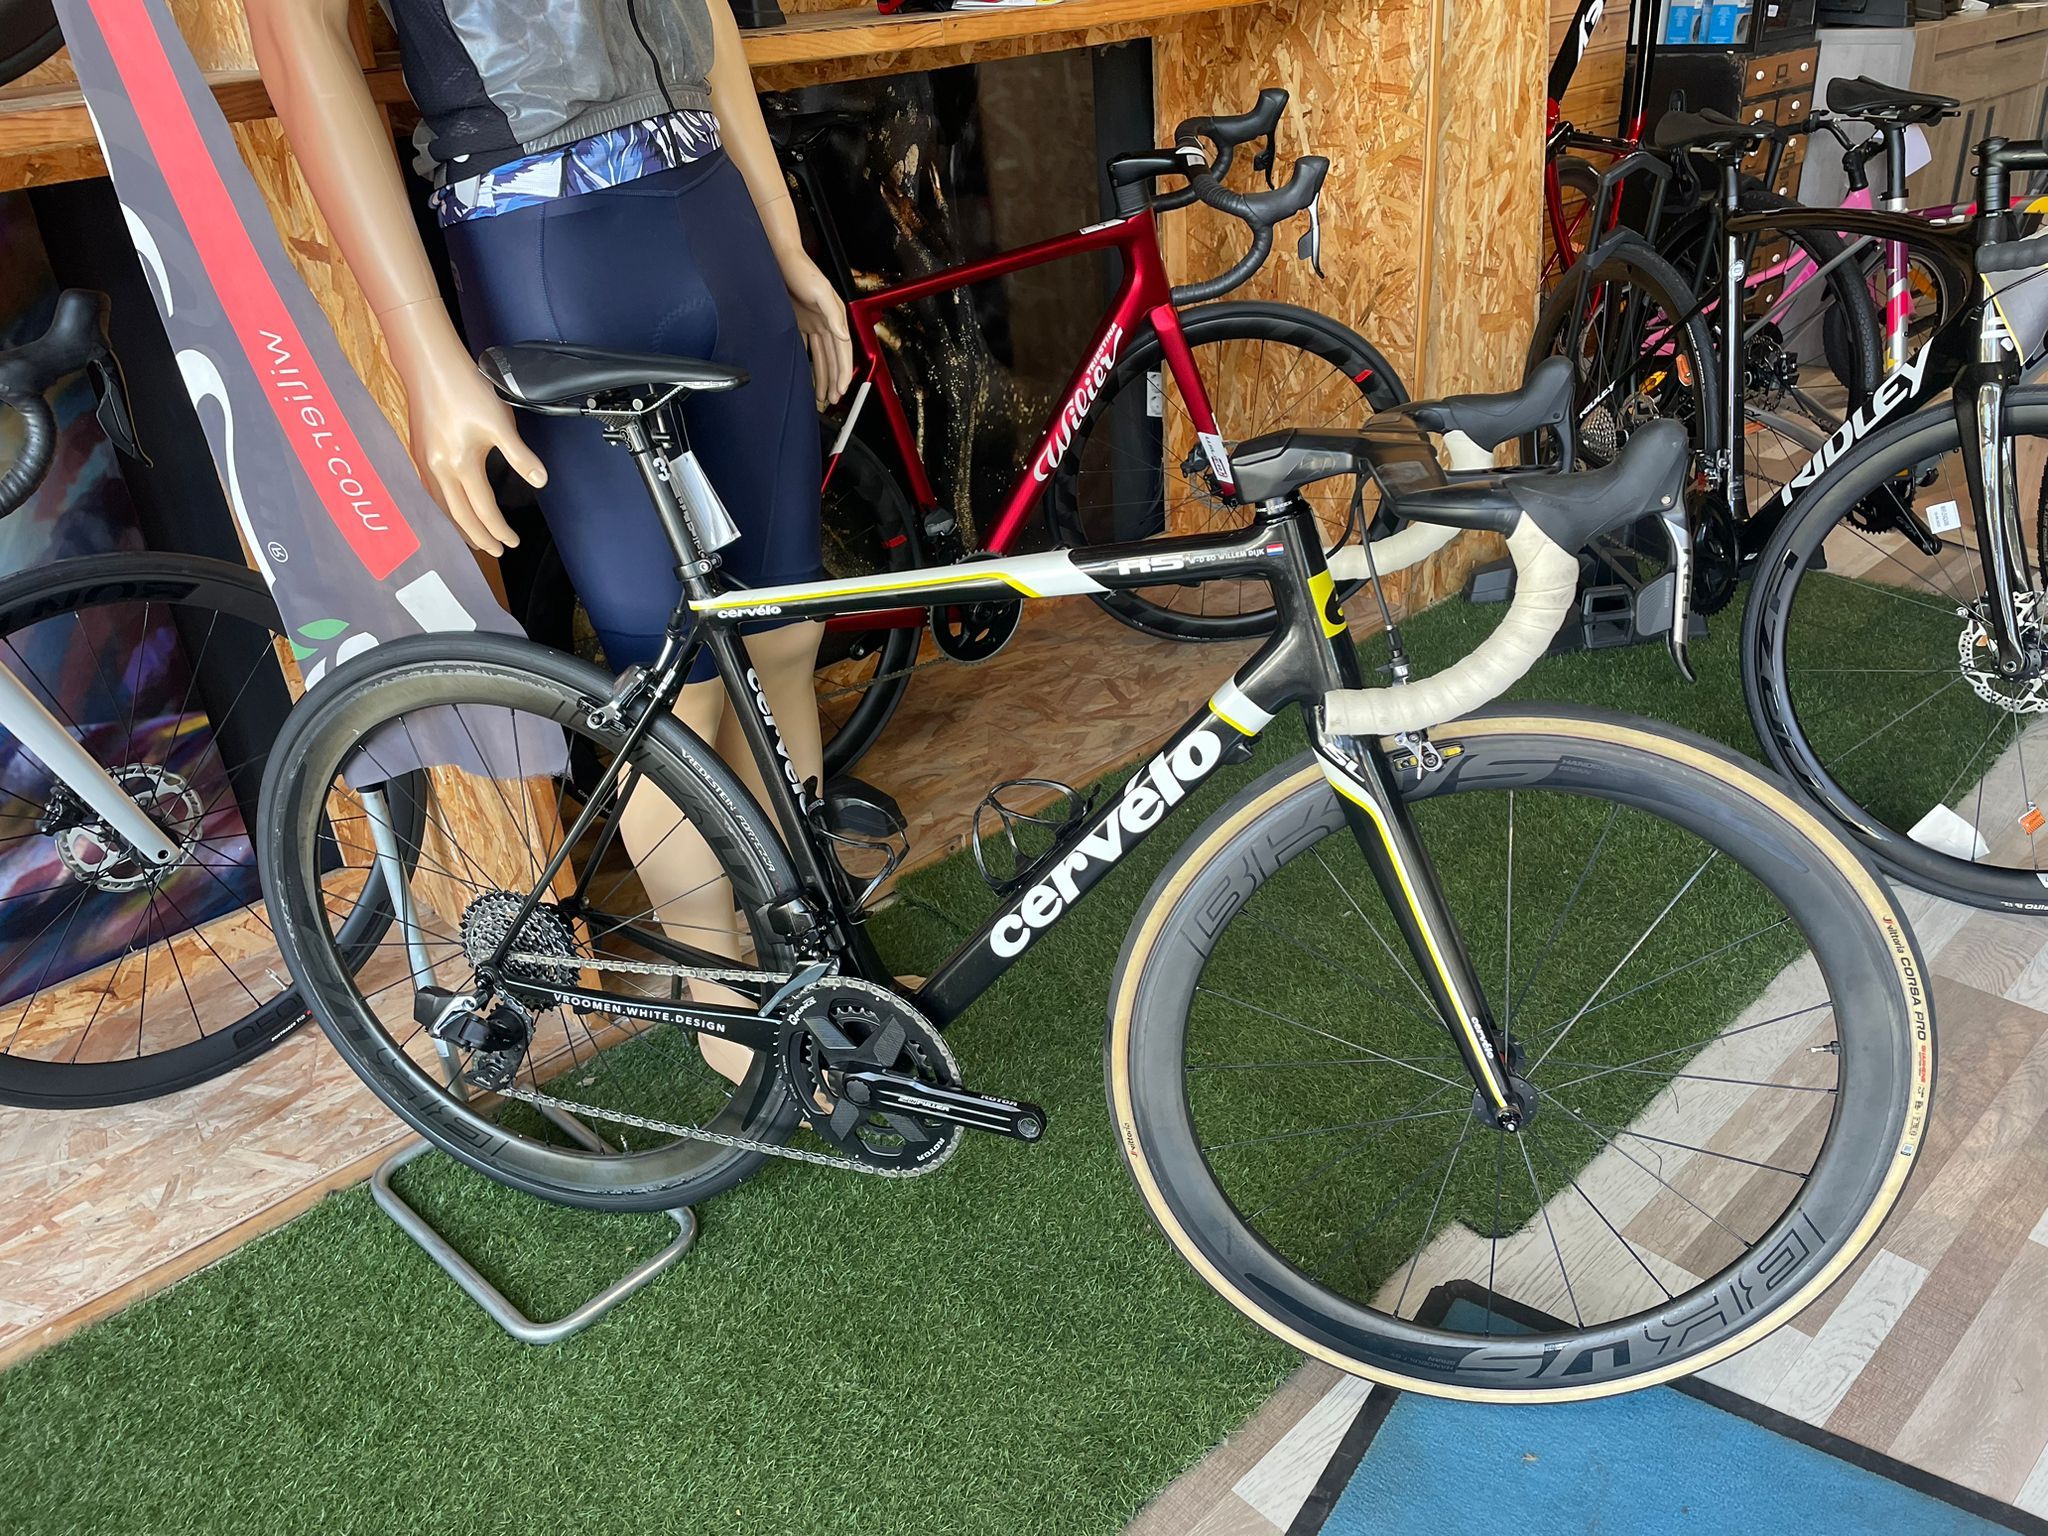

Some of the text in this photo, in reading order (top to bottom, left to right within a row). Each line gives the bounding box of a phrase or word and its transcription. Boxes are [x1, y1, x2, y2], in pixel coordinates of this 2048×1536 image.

[1086, 321, 1118, 375] TRIESTINA
[258, 329, 389, 532] wilier.com
[1033, 327, 1124, 482] Wilier
[1780, 335, 1935, 508] RIDLEY
[1248, 548, 1265, 559] DIJK
[716, 603, 783, 619] cervélo
[680, 747, 737, 813] VREDESTEIN
[989, 729, 1222, 959] cervélo
[552, 992, 727, 1034] VROOMEN.WHITE.DESIGN
[1886, 924, 1927, 1042] vittoria CORSA PRO
[980, 1094, 1019, 1107] ROTOR
[916, 1137, 946, 1162] ROTOR
